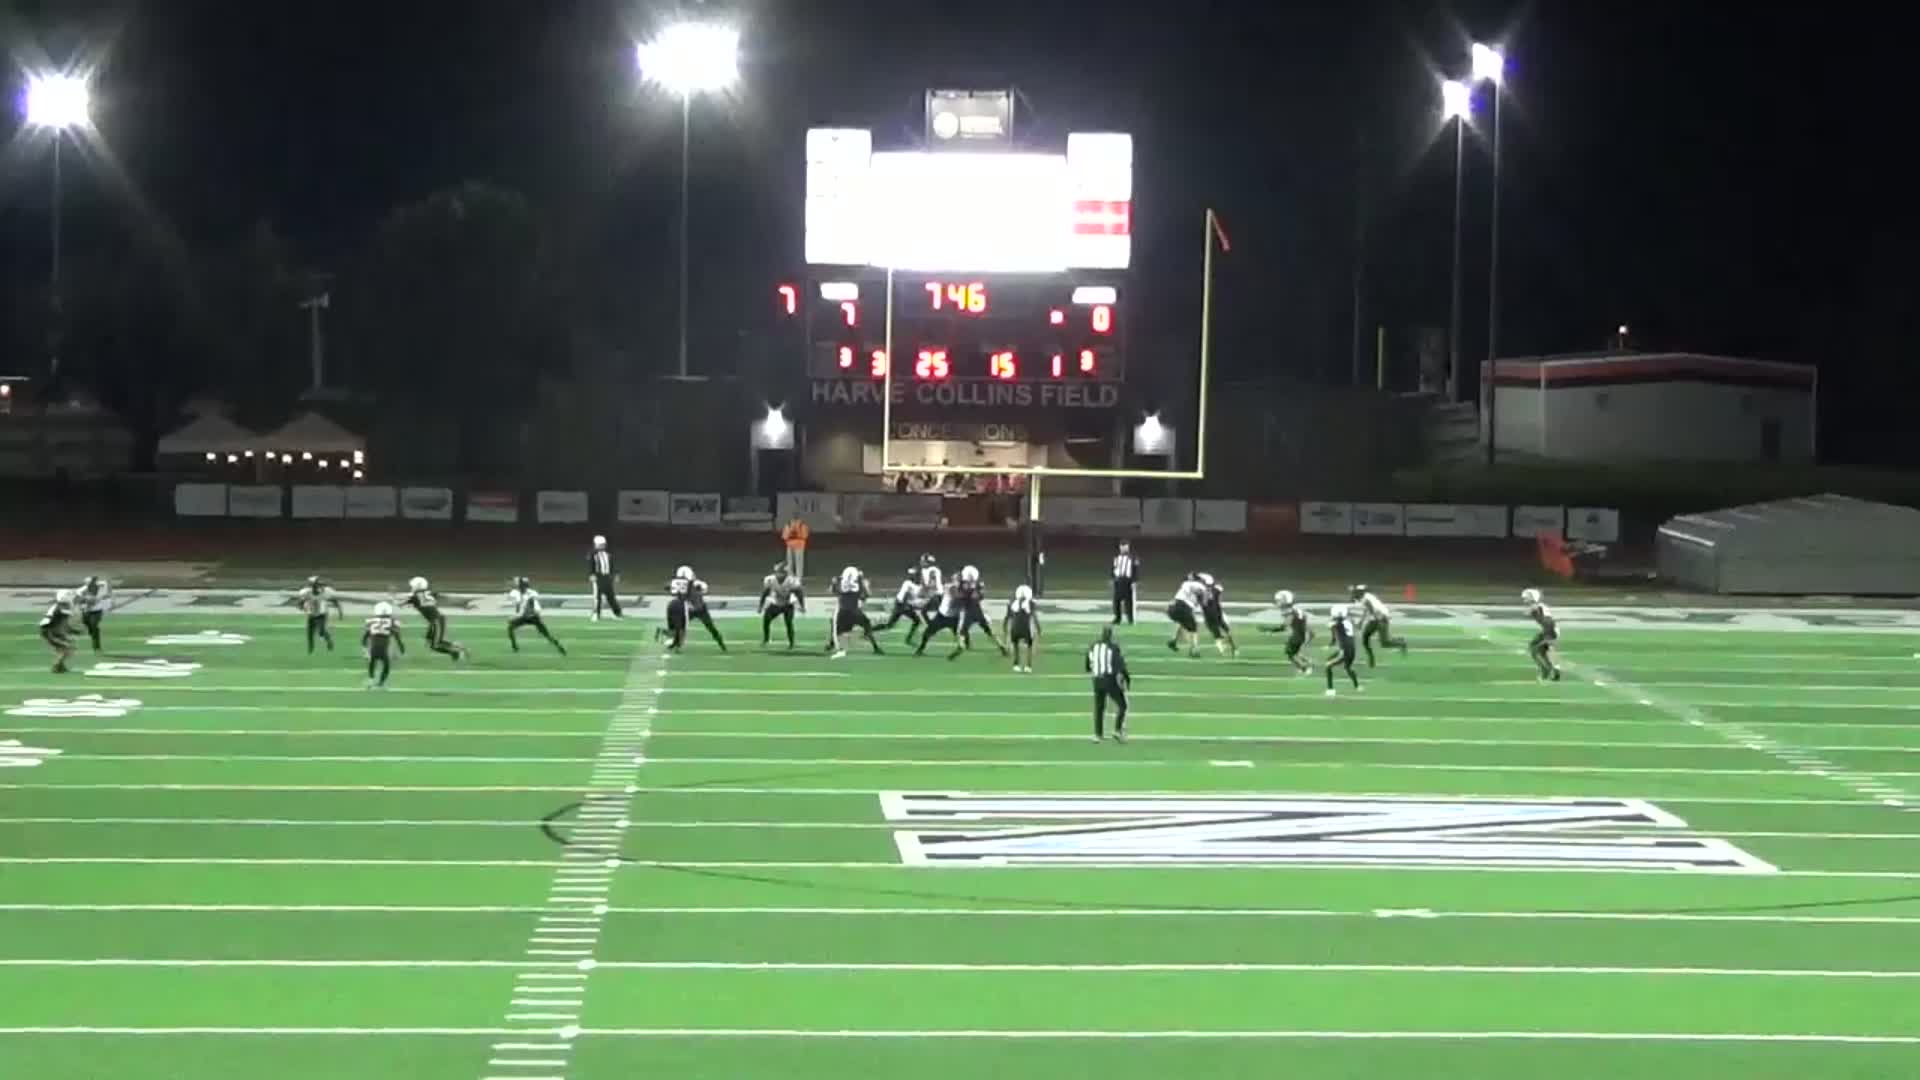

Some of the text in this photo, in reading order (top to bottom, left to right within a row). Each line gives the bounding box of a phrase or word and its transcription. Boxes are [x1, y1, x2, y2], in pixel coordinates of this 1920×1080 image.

[841, 302, 855, 325] 7
[1093, 305, 1110, 332] 0
[840, 347, 851, 368] 3
[916, 351, 948, 377] 25
[991, 352, 1015, 379] 15
[1053, 355, 1061, 377] 1
[1080, 350, 1093, 371] 3
[811, 381, 1119, 407] HARVE COLLINS FIELD
[367, 617, 392, 635] 22
